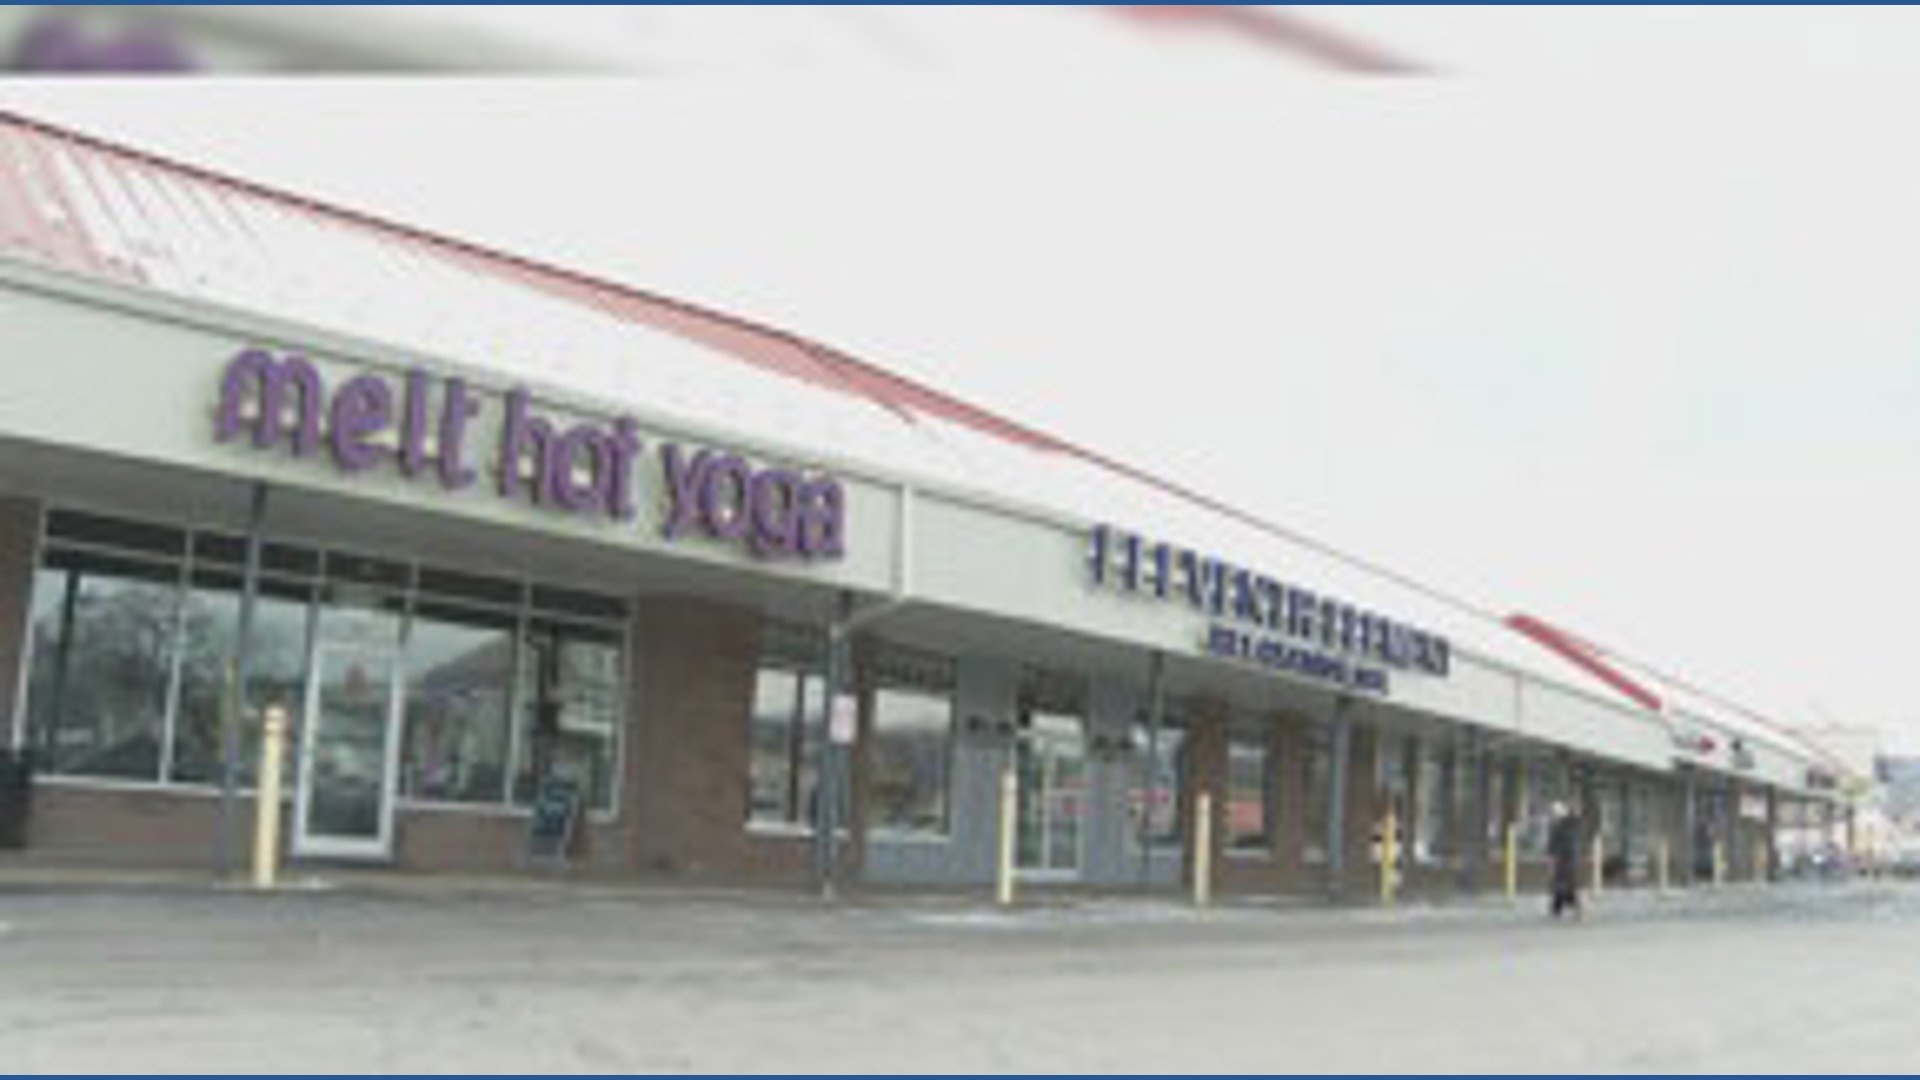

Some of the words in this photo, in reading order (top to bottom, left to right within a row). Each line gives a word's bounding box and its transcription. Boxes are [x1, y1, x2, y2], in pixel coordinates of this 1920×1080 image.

[214, 347, 479, 488] melt
[497, 383, 640, 521] hot
[659, 441, 845, 561] yoga
